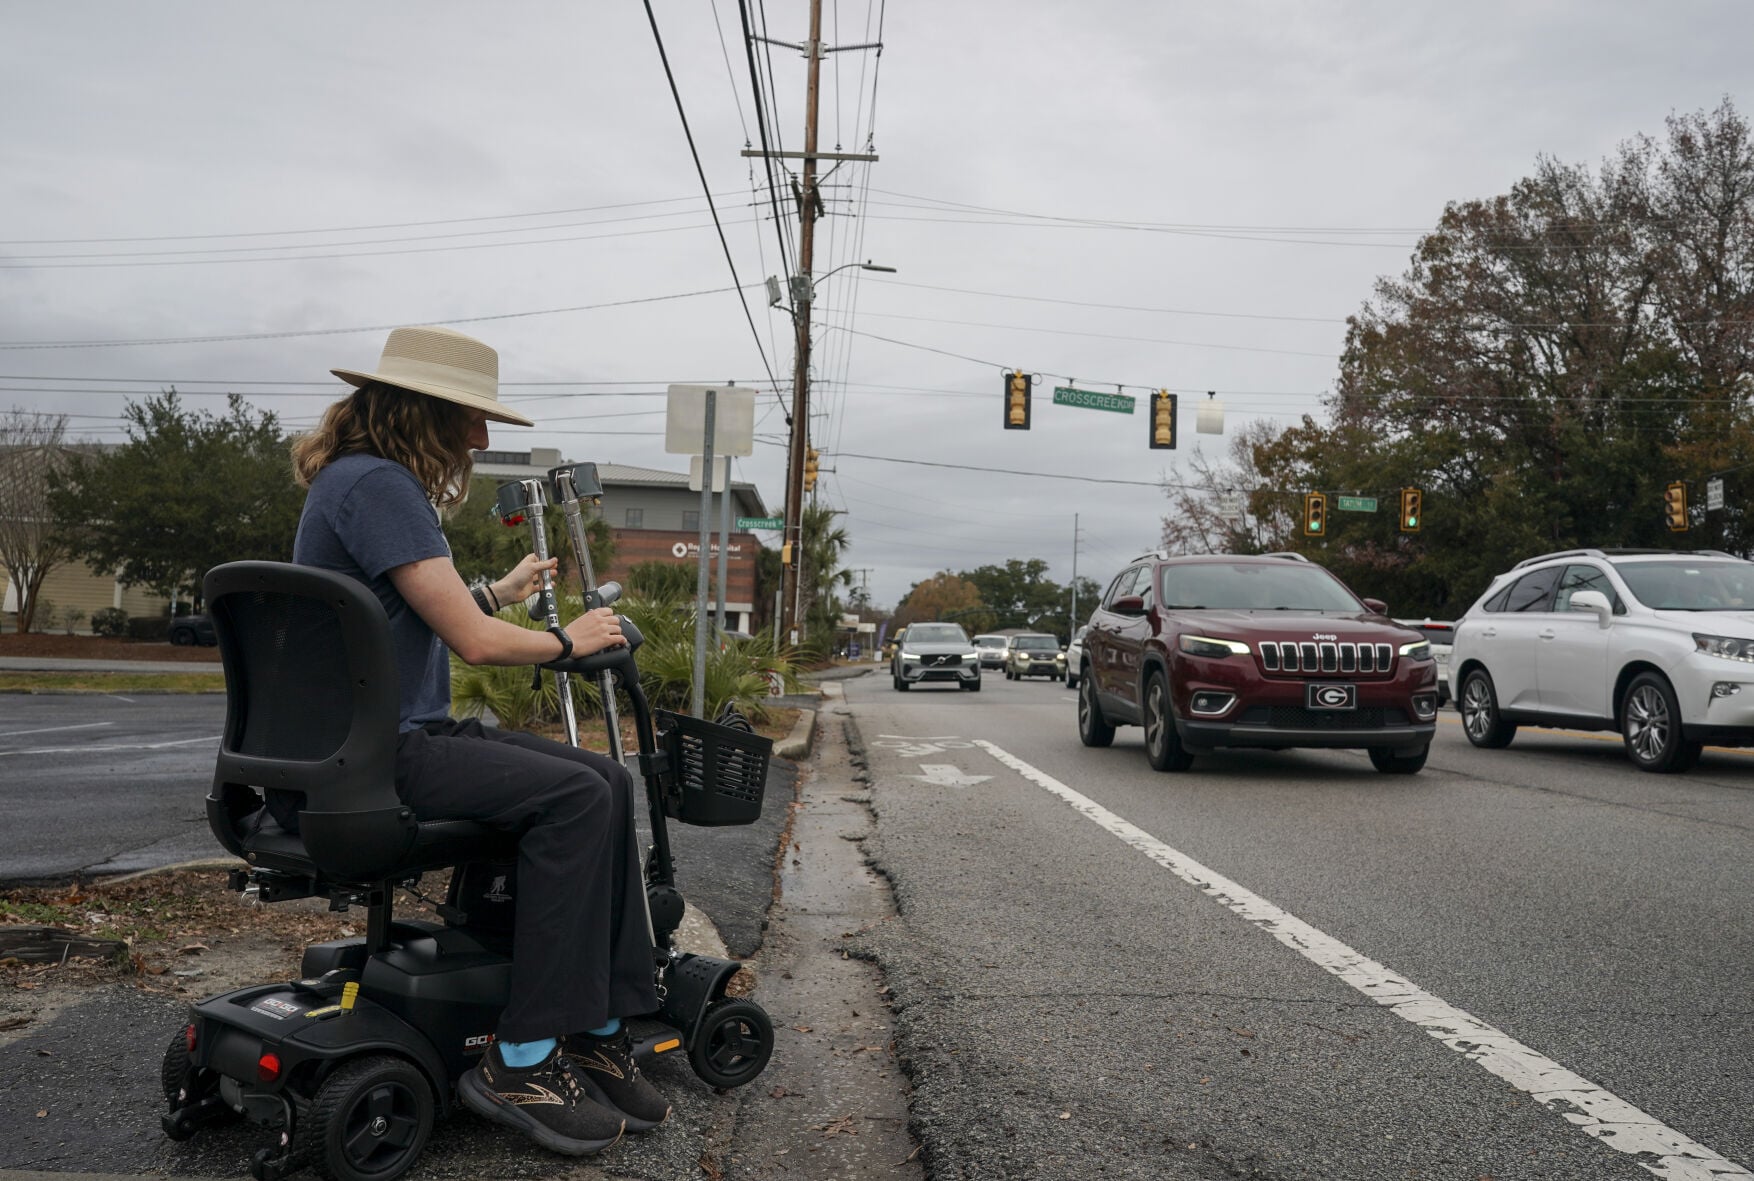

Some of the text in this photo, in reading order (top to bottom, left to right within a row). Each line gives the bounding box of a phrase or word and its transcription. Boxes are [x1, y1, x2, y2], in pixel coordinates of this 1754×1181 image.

[1054, 390, 1123, 409] CROSSCREEK
[737, 518, 777, 529] Crosscreek
[1313, 633, 1337, 641] Jeep
